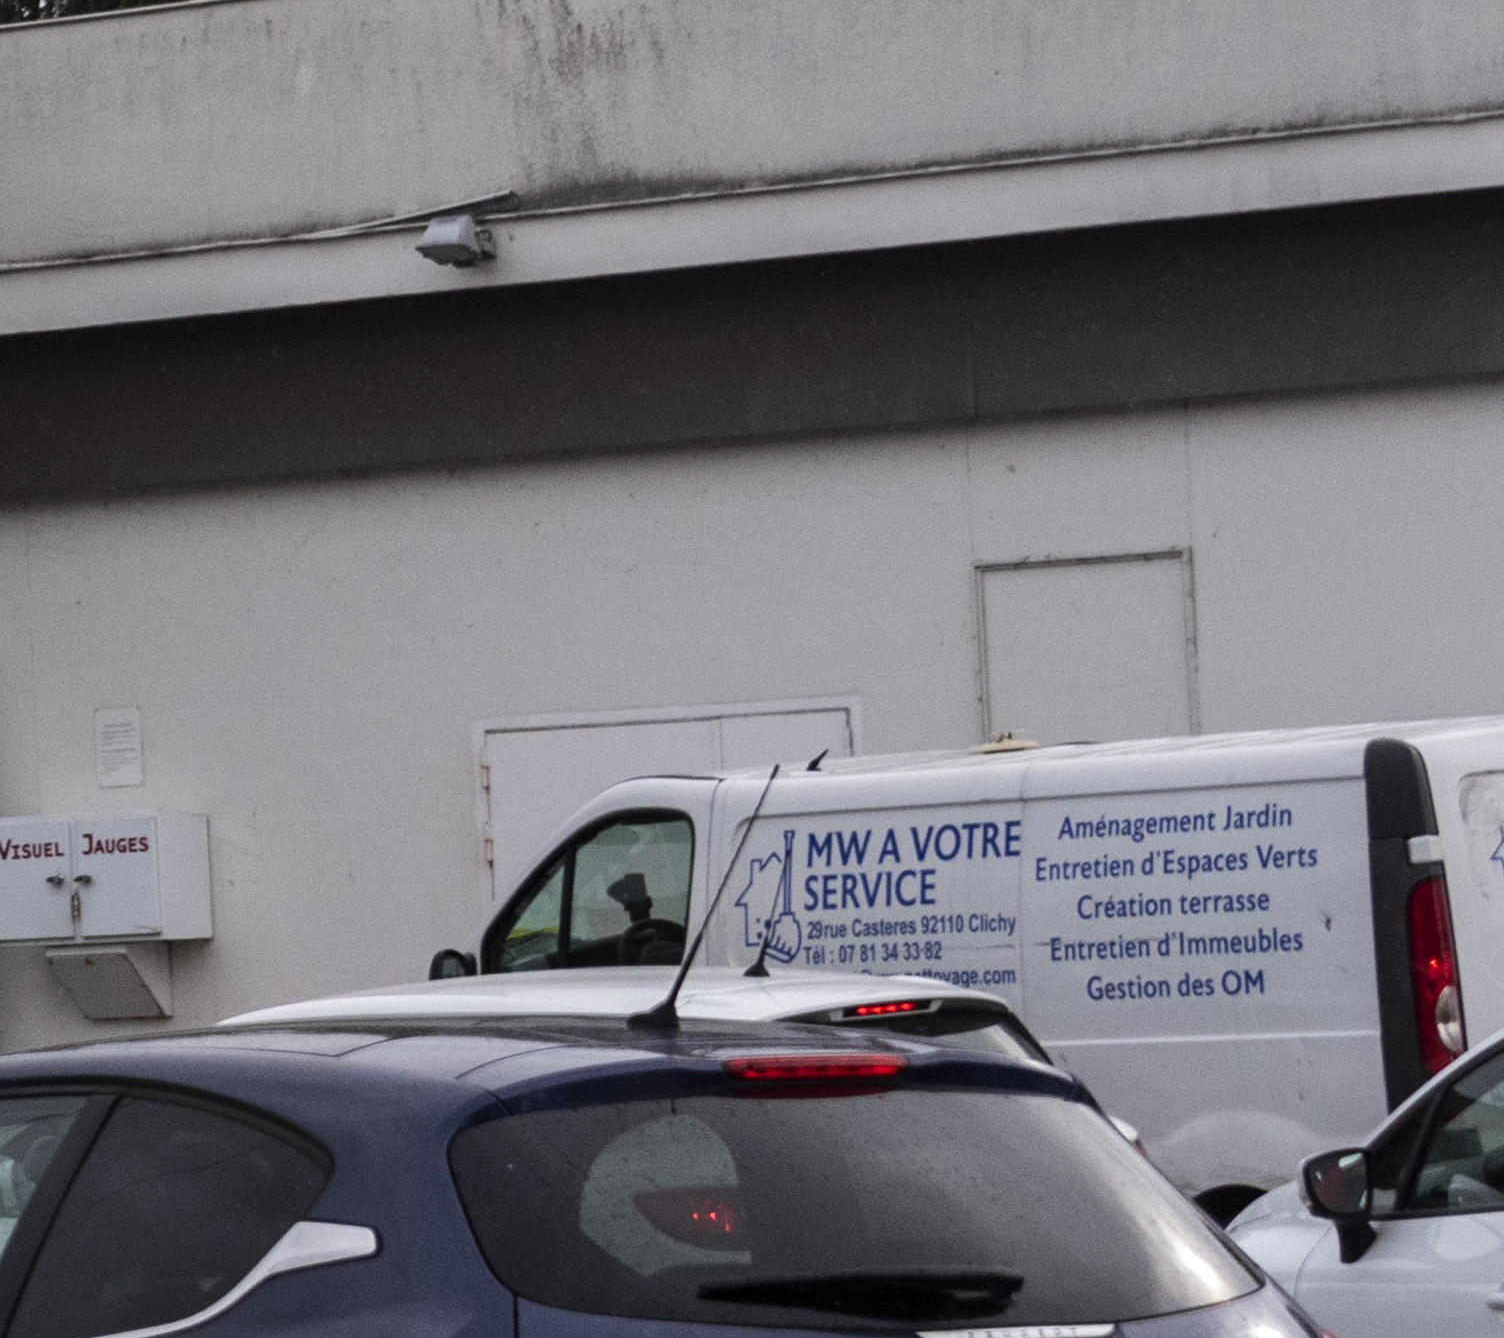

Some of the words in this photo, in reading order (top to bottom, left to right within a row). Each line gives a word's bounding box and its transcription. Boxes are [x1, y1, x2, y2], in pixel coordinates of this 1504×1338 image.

[1058, 811, 1216, 843] Aménagement
[1223, 803, 1293, 832] Jardin
[82, 833, 150, 856] JAUGES
[806, 829, 872, 868] MW
[910, 820, 1022, 862] VOTRE
[1035, 855, 1135, 882] Entretien
[1141, 849, 1249, 880] d'Espaces
[1256, 843, 1318, 869] Verts
[804, 869, 937, 911] SERVICE
[1077, 892, 1172, 920] Création
[1179, 892, 1270, 915] terrasse
[852, 918, 917, 938] Casteres
[921, 914, 964, 935] 92110
[968, 912, 1016, 936] Clichy
[839, 944, 855, 964] 07
[860, 943, 876, 962] 81
[881, 942, 899, 961] 34
[903, 941, 920, 961] 33
[924, 941, 942, 961] 82
[1050, 934, 1150, 962] Entretien
[1157, 927, 1304, 957] d'Immeubles
[1087, 975, 1171, 1001] Gestion
[1177, 971, 1215, 997] des
[1221, 969, 1266, 996] OM
